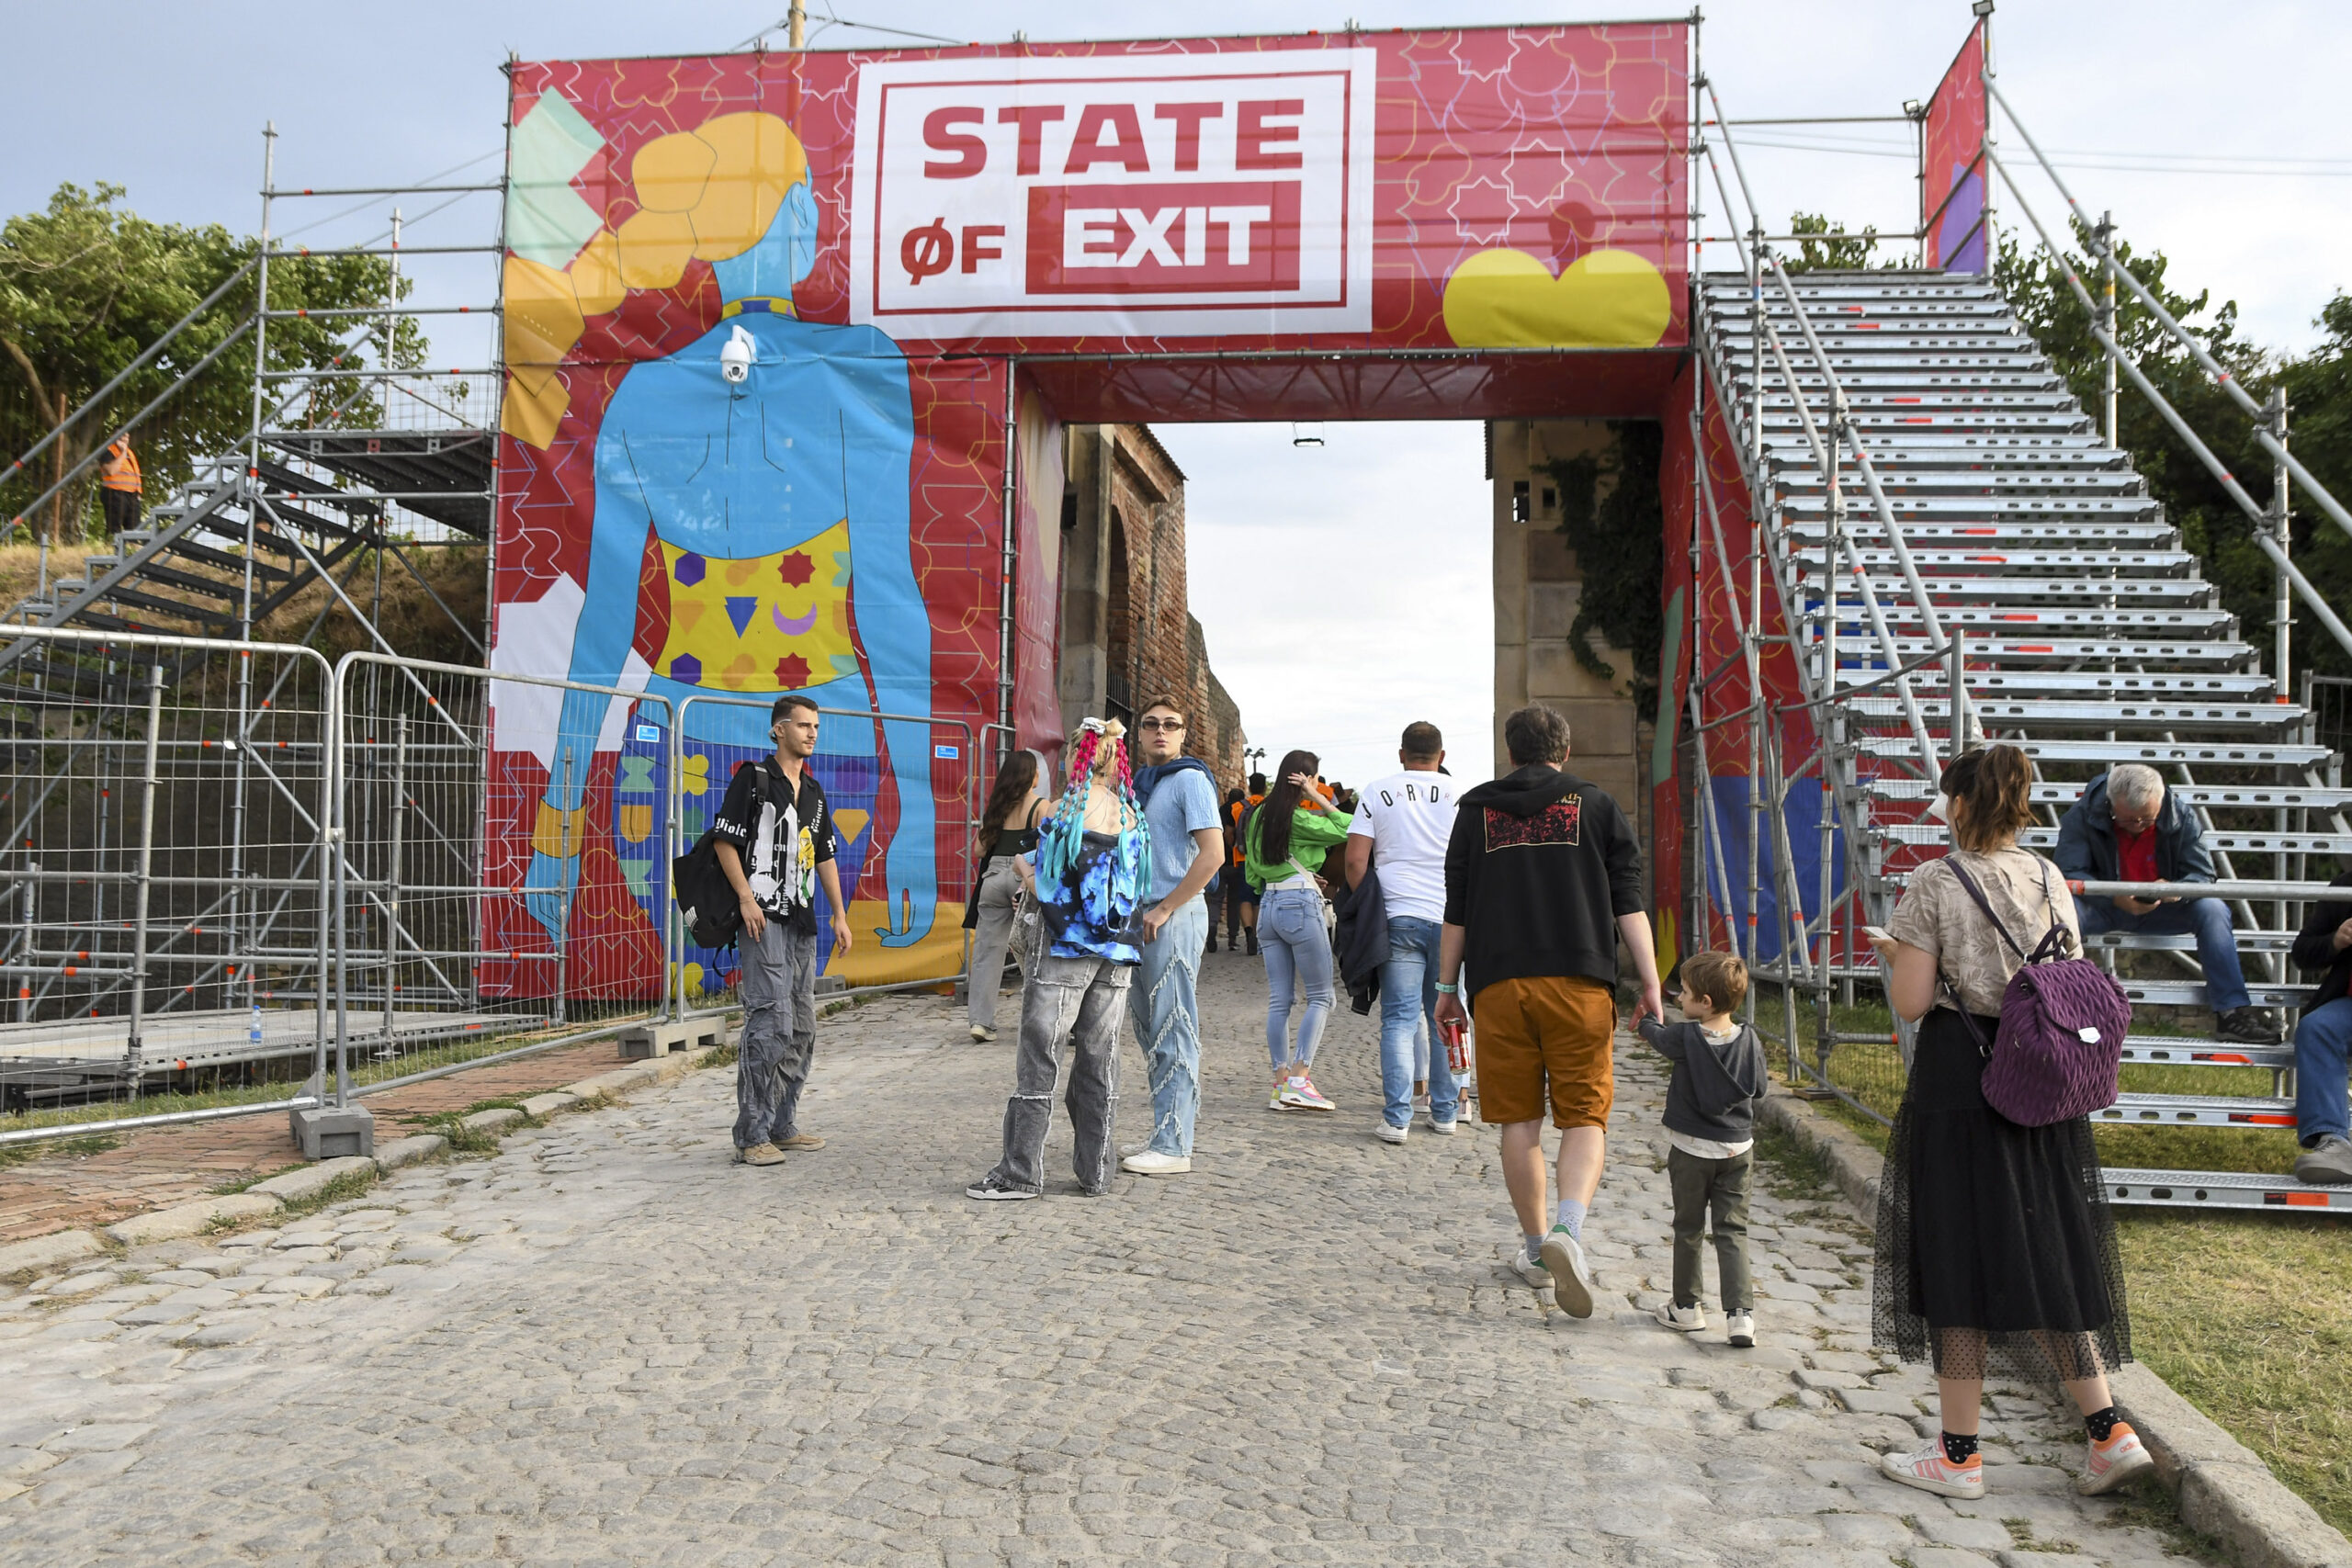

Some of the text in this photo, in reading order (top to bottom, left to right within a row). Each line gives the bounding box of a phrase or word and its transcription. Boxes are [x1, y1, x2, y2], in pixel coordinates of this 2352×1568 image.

[922, 99, 1304, 179] STATE
[900, 206, 1271, 286] ØF EXIT
